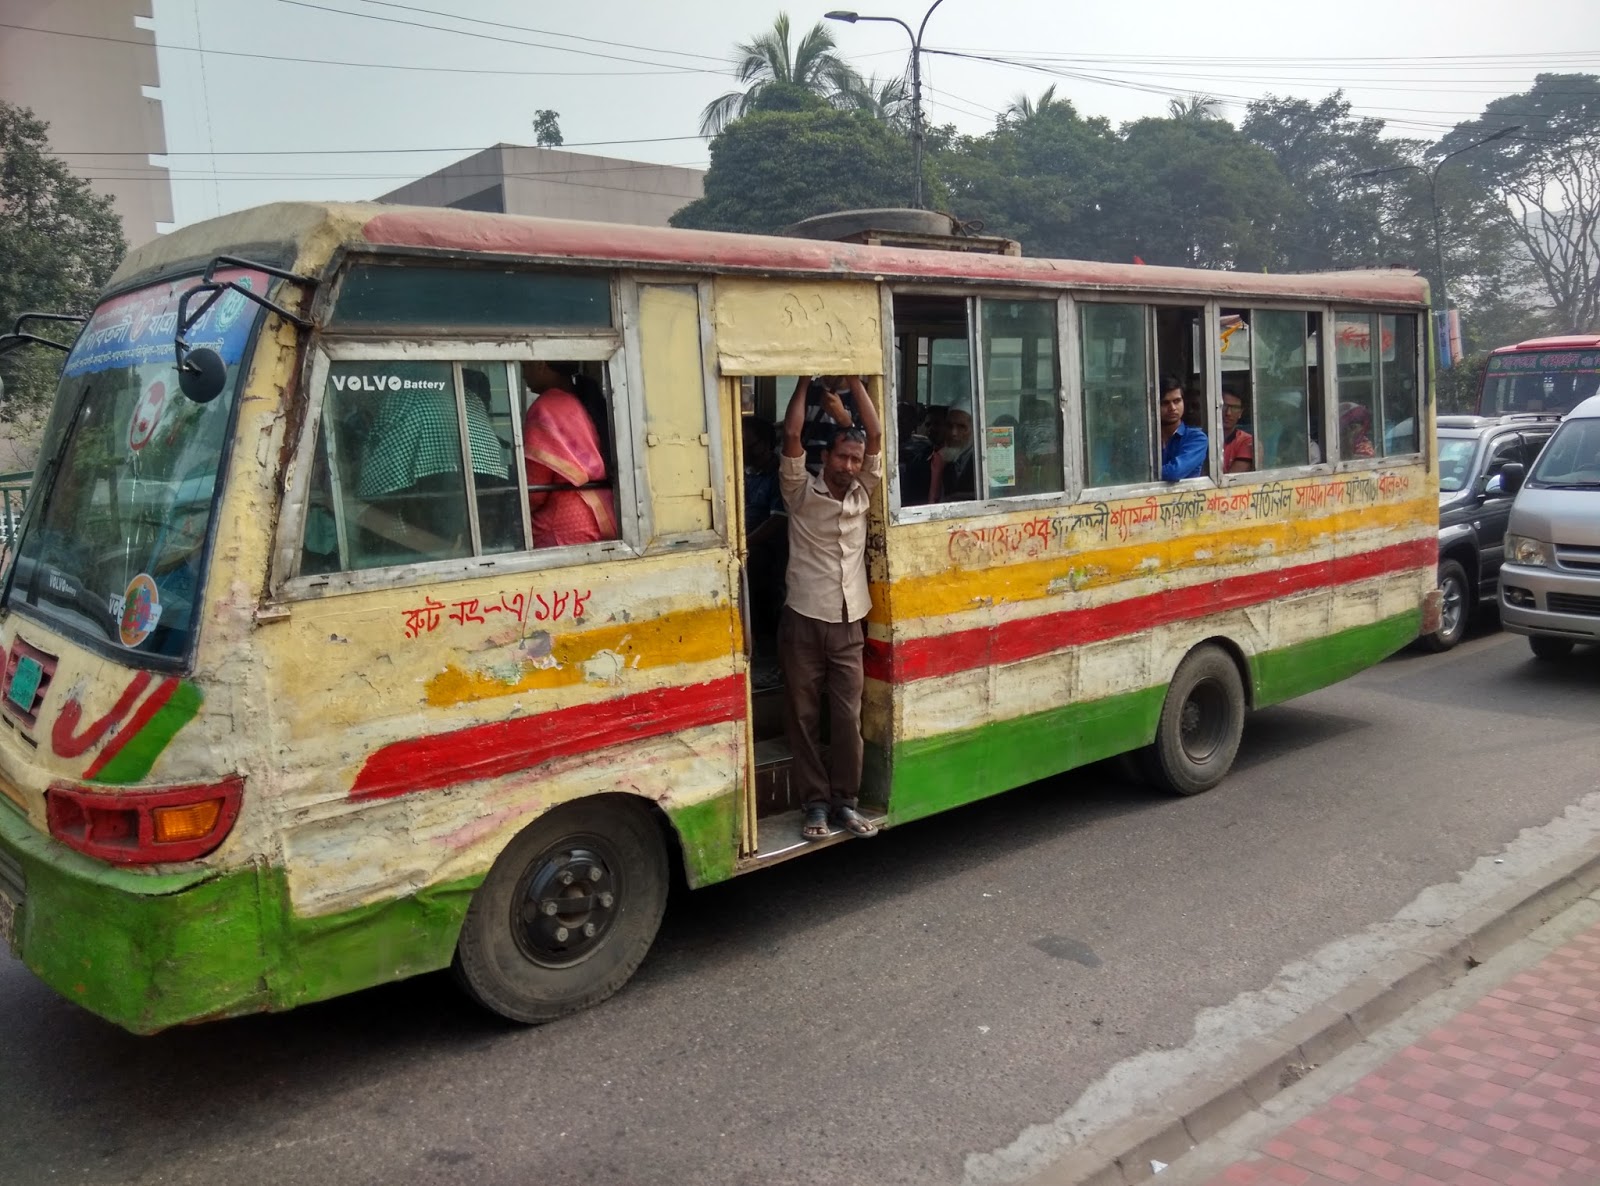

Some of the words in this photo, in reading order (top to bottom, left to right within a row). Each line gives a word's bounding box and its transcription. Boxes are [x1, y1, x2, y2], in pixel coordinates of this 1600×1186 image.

[332, 375, 402, 391] VOLVO
[403, 379, 446, 391] Battery
[401, 596, 446, 638] রুট
